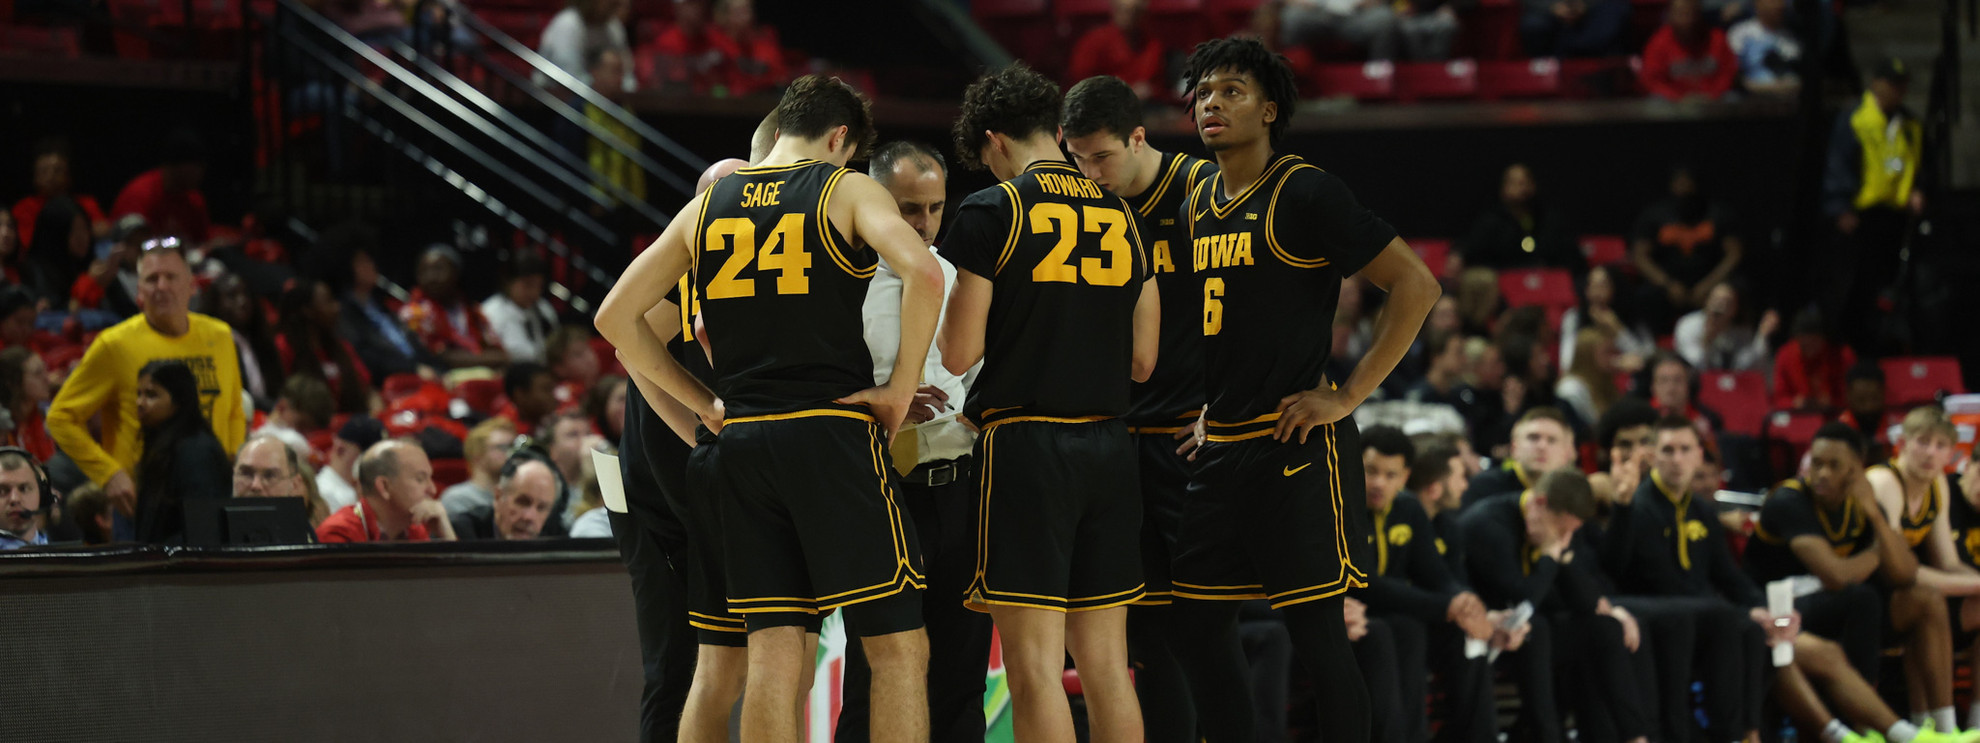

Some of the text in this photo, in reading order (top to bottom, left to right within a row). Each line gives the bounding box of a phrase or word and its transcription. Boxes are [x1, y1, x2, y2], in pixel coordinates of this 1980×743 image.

[740, 180, 786, 208] SAGE
[1034, 173, 1104, 199] HOWARD
[705, 212, 812, 300] 24
[1028, 202, 1133, 287] 23
[1193, 231, 1255, 273] IOWA
[1203, 277, 1225, 336] 6
